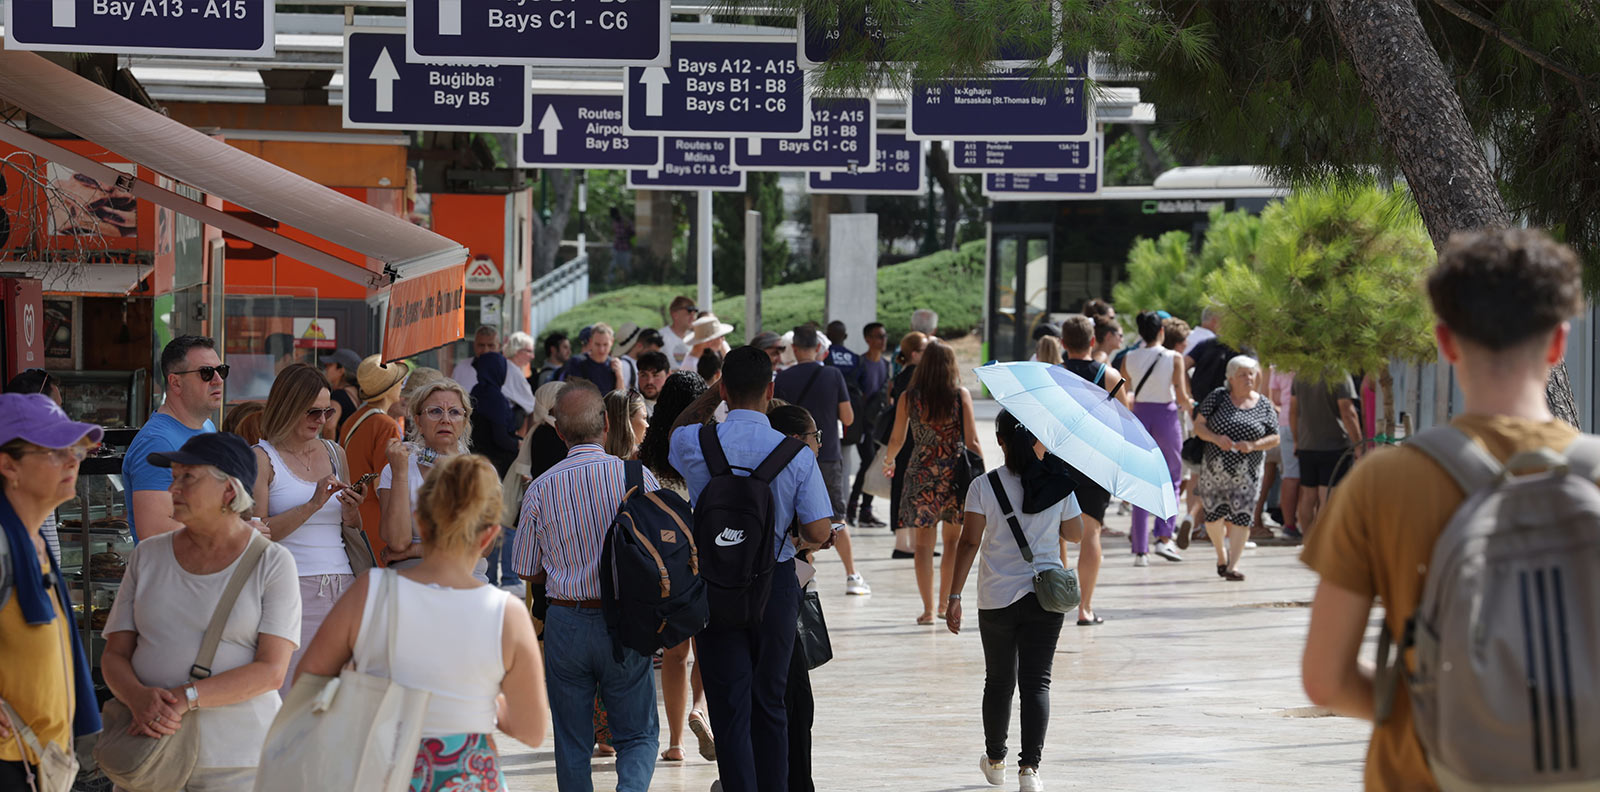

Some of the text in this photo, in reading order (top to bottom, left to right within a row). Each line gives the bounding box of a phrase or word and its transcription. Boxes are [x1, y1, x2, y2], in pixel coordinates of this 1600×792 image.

[93, 0, 136, 21] Bay
[140, 0, 184, 18] A13
[203, 0, 247, 20] A15
[488, 9, 542, 32] Bays
[549, 9, 576, 29] C1
[599, 10, 628, 30] C6
[825, 30, 840, 40] A9
[678, 58, 717, 76] Bays
[720, 59, 751, 74] A12
[764, 60, 795, 75] A15
[429, 71, 495, 89] Buġibba
[686, 78, 726, 95] Bays
[730, 79, 749, 93] B1
[766, 79, 786, 93] B8
[434, 91, 490, 108] Bay B5
[686, 97, 725, 114] Bays
[730, 98, 749, 112] C1
[765, 98, 786, 112] C6
[1031, 97, 1047, 106] Bay)
[578, 107, 622, 120] Routes
[840, 111, 864, 122] A15
[813, 125, 829, 137] B1
[840, 125, 857, 137] B8
[586, 138, 629, 151] Bay B3
[676, 140, 724, 150] Routes to
[779, 140, 810, 154] Bays
[813, 140, 829, 151] C1
[840, 140, 857, 151] C6
[684, 152, 715, 162] Mdina
[896, 150, 909, 160] B8
[665, 164, 691, 176] Bays
[693, 164, 707, 174] C1
[709, 165, 718, 175] &
[895, 163, 909, 172] C6
[721, 527, 744, 541] NIKE
